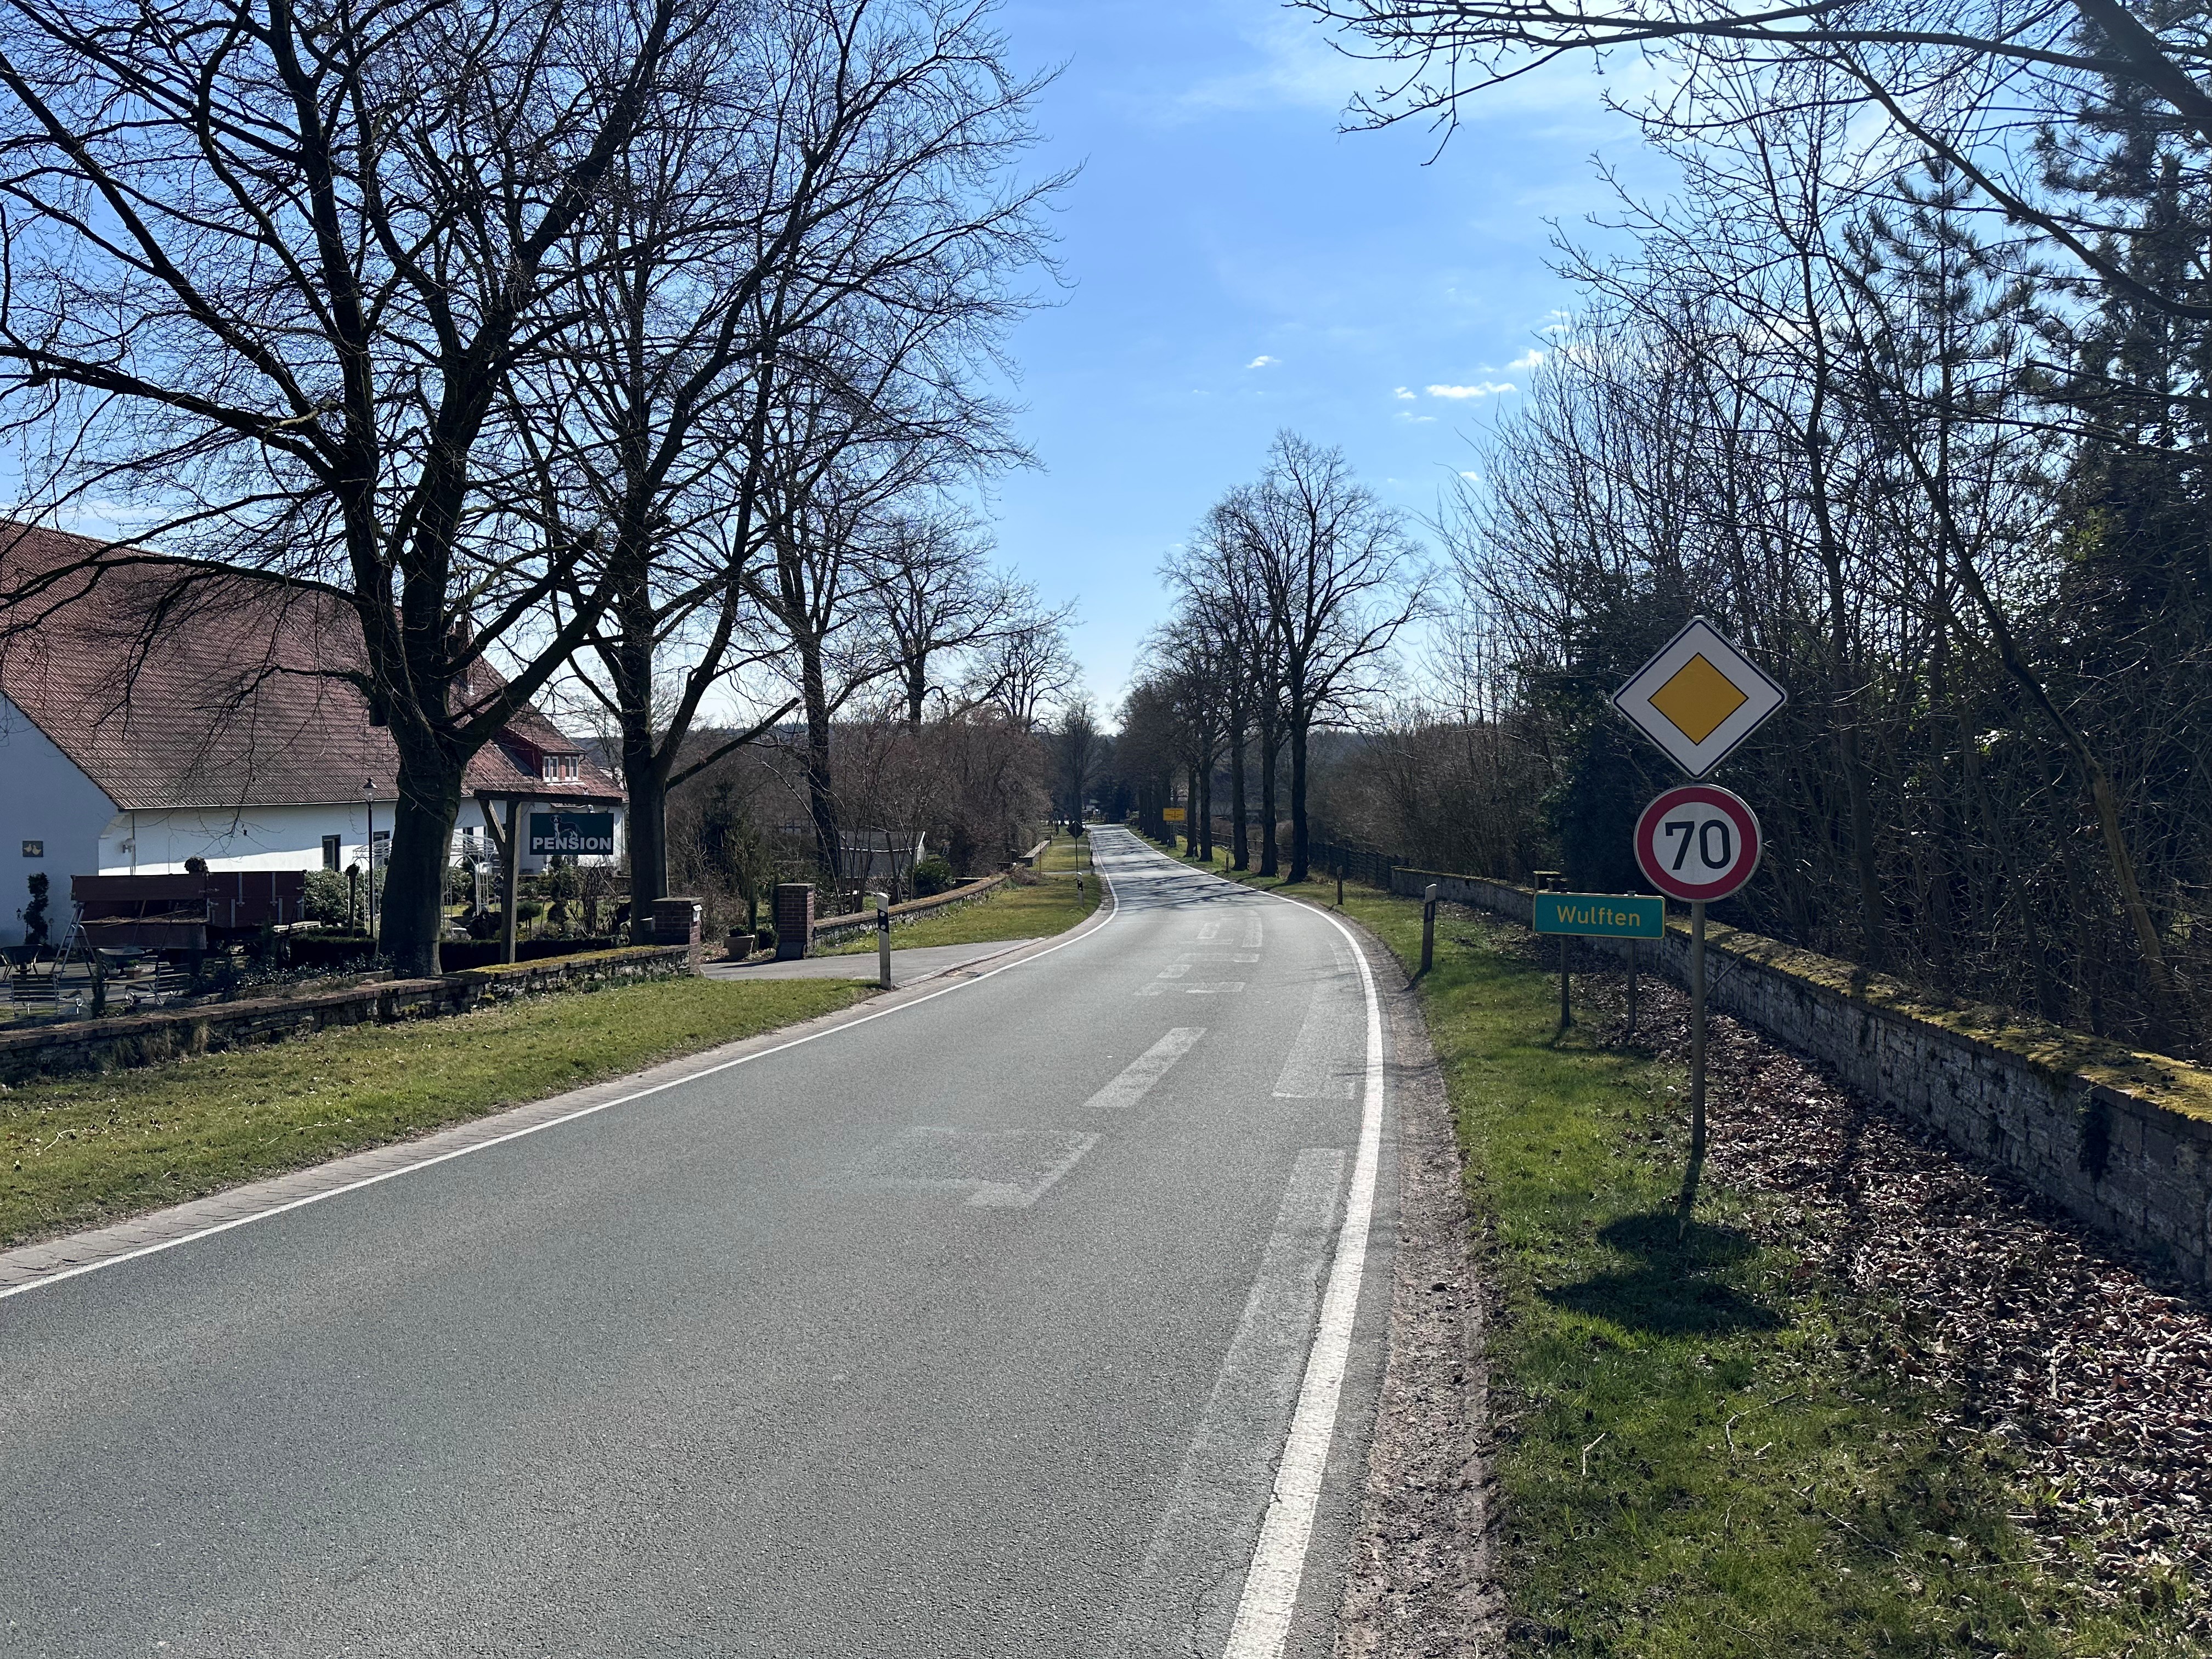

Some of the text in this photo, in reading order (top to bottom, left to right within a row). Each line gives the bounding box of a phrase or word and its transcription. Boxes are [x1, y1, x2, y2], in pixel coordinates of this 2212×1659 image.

[533, 837, 612, 850] PENSION
[1664, 819, 1731, 870] 70
[1557, 905, 1640, 927] Wulften
